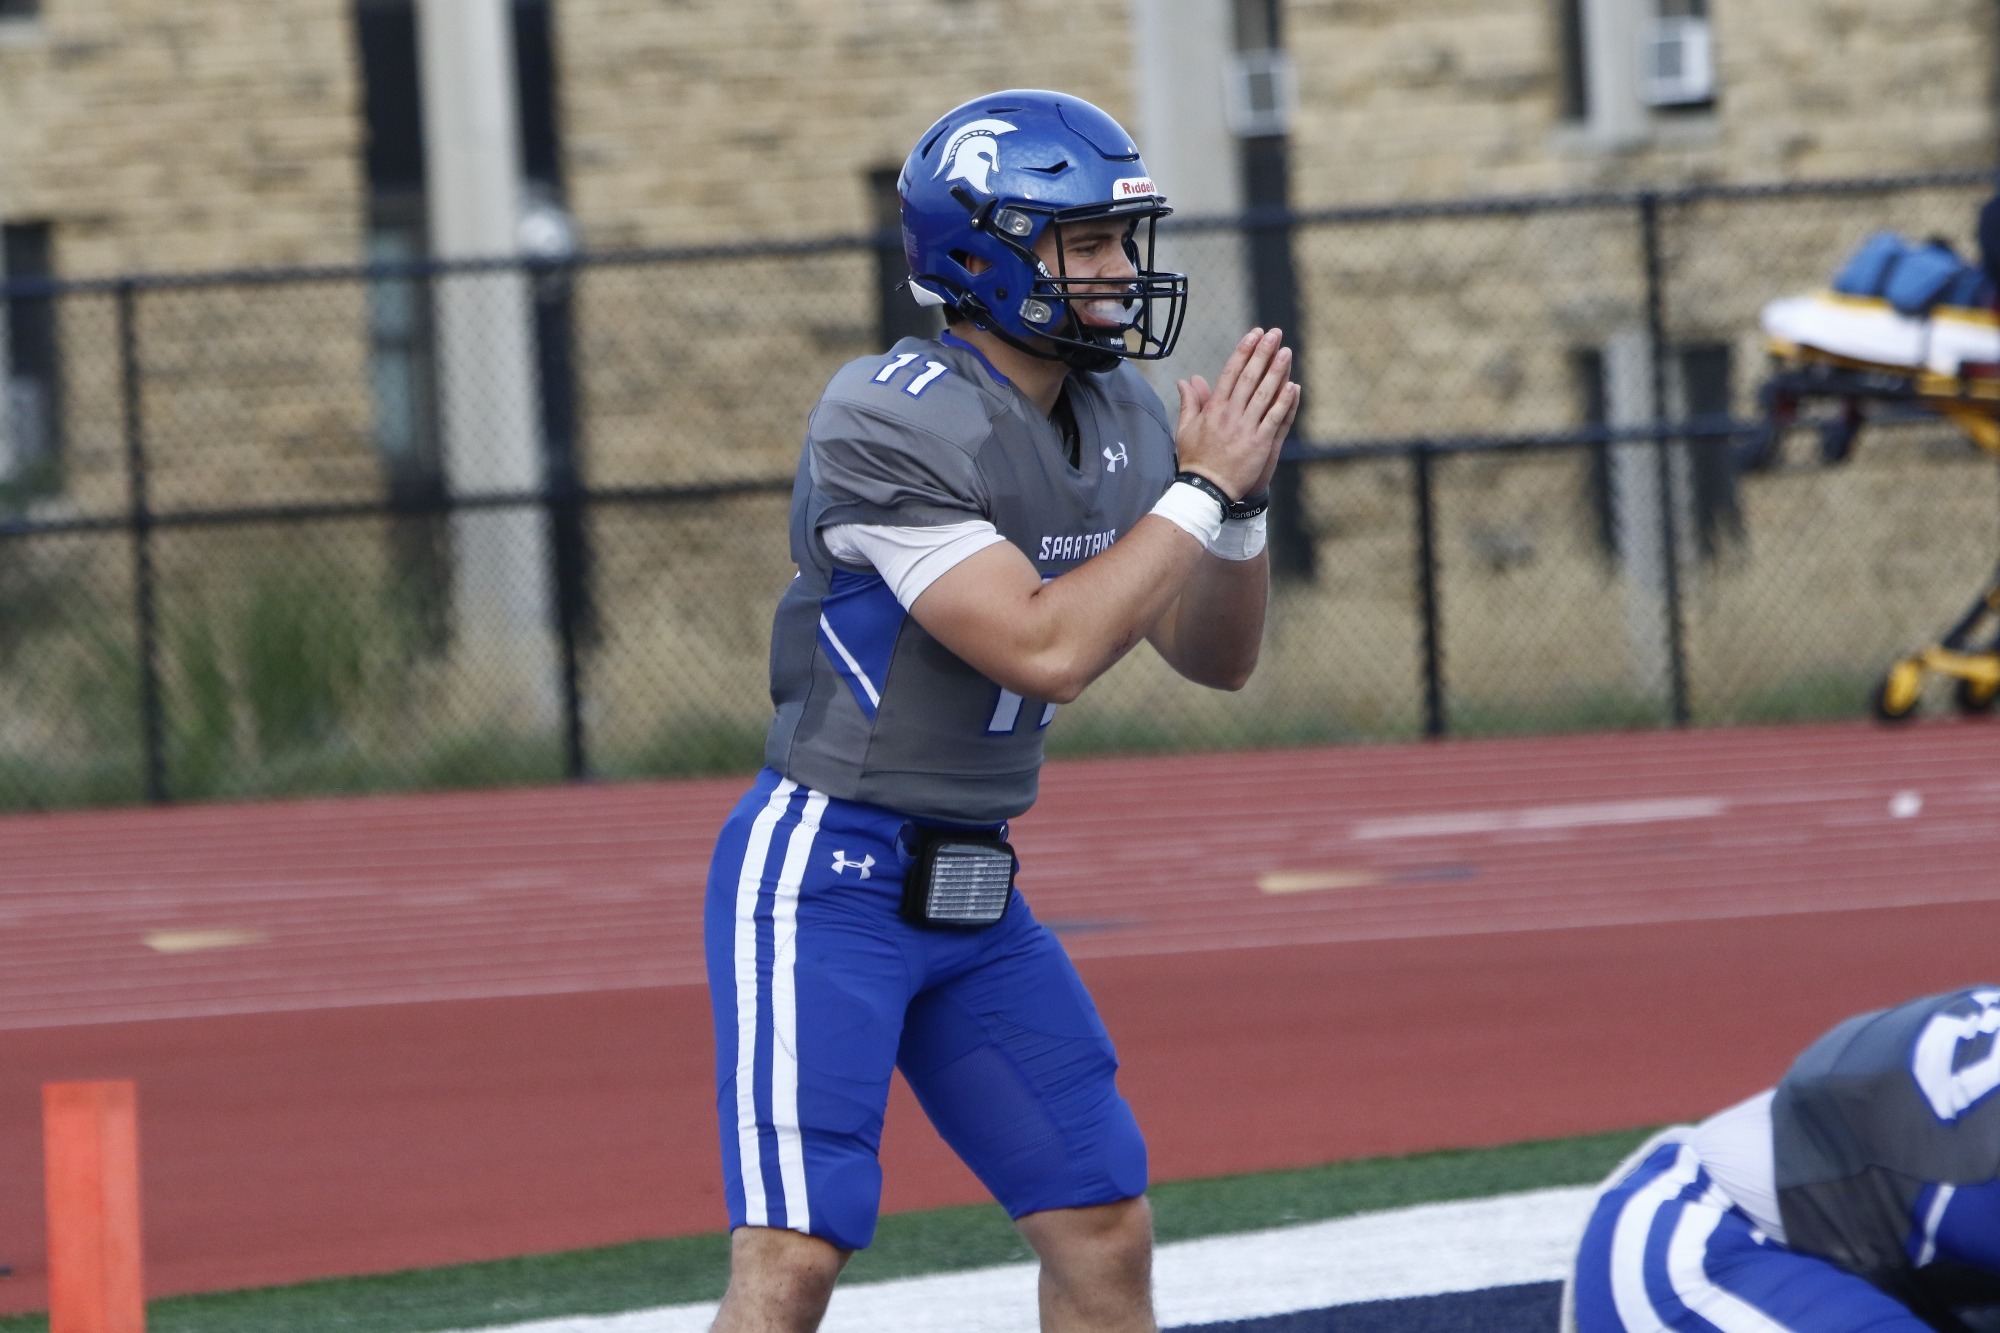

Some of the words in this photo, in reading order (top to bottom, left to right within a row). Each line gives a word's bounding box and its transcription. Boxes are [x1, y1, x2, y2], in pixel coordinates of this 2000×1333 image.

[1122, 181, 1155, 195] Riddell
[870, 352, 950, 399] 11
[1229, 507, 1261, 519] DUBUQU
[1038, 528, 1116, 560] SPARTANS
